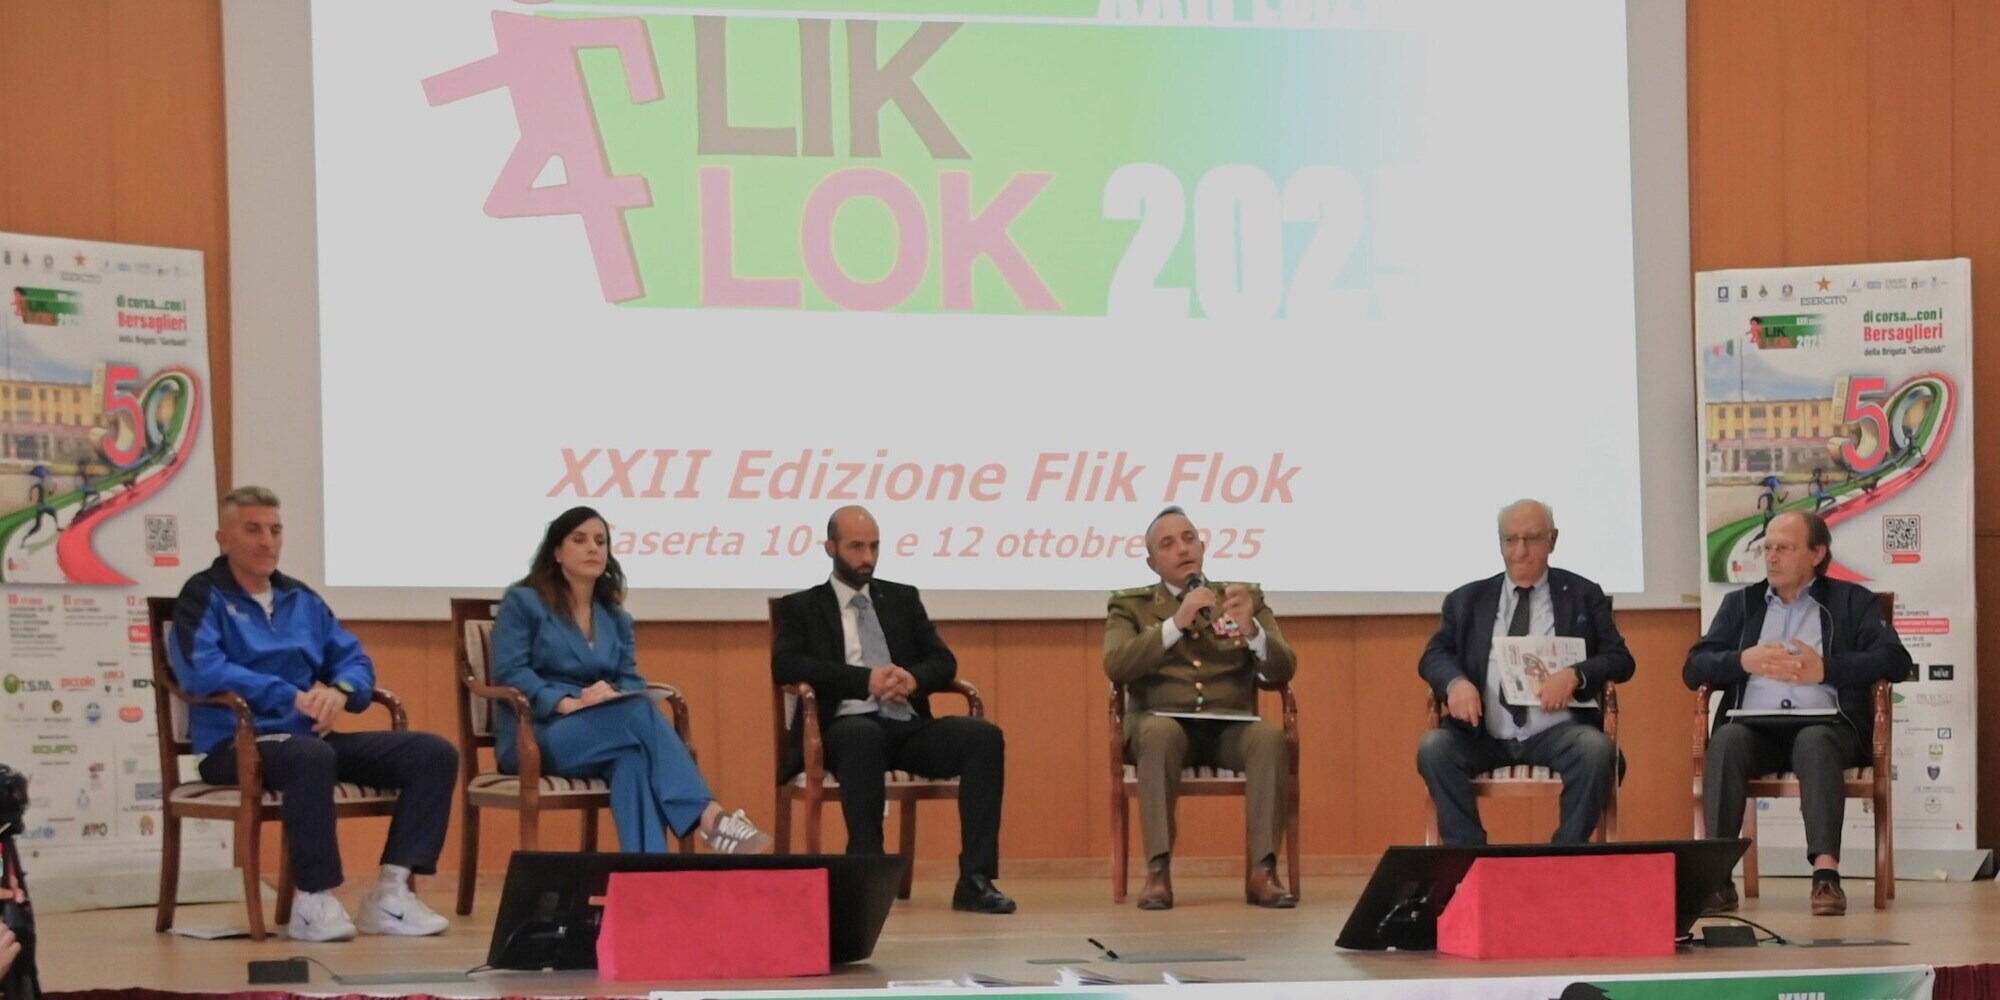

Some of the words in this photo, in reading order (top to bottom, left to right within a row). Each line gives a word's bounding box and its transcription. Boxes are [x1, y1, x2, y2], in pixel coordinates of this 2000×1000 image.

[1800, 297, 1847, 306] ESERCITO
[1863, 323, 1943, 344] Bersaglieri
[546, 448, 712, 499] XXII
[728, 448, 1007, 502] Edizione
[1026, 450, 1146, 502] Flik
[1163, 451, 1302, 504] Flok
[608, 524, 746, 557] aserta
[895, 531, 919, 557] e
[933, 525, 985, 558] 12
[996, 525, 1148, 560] ottobre
